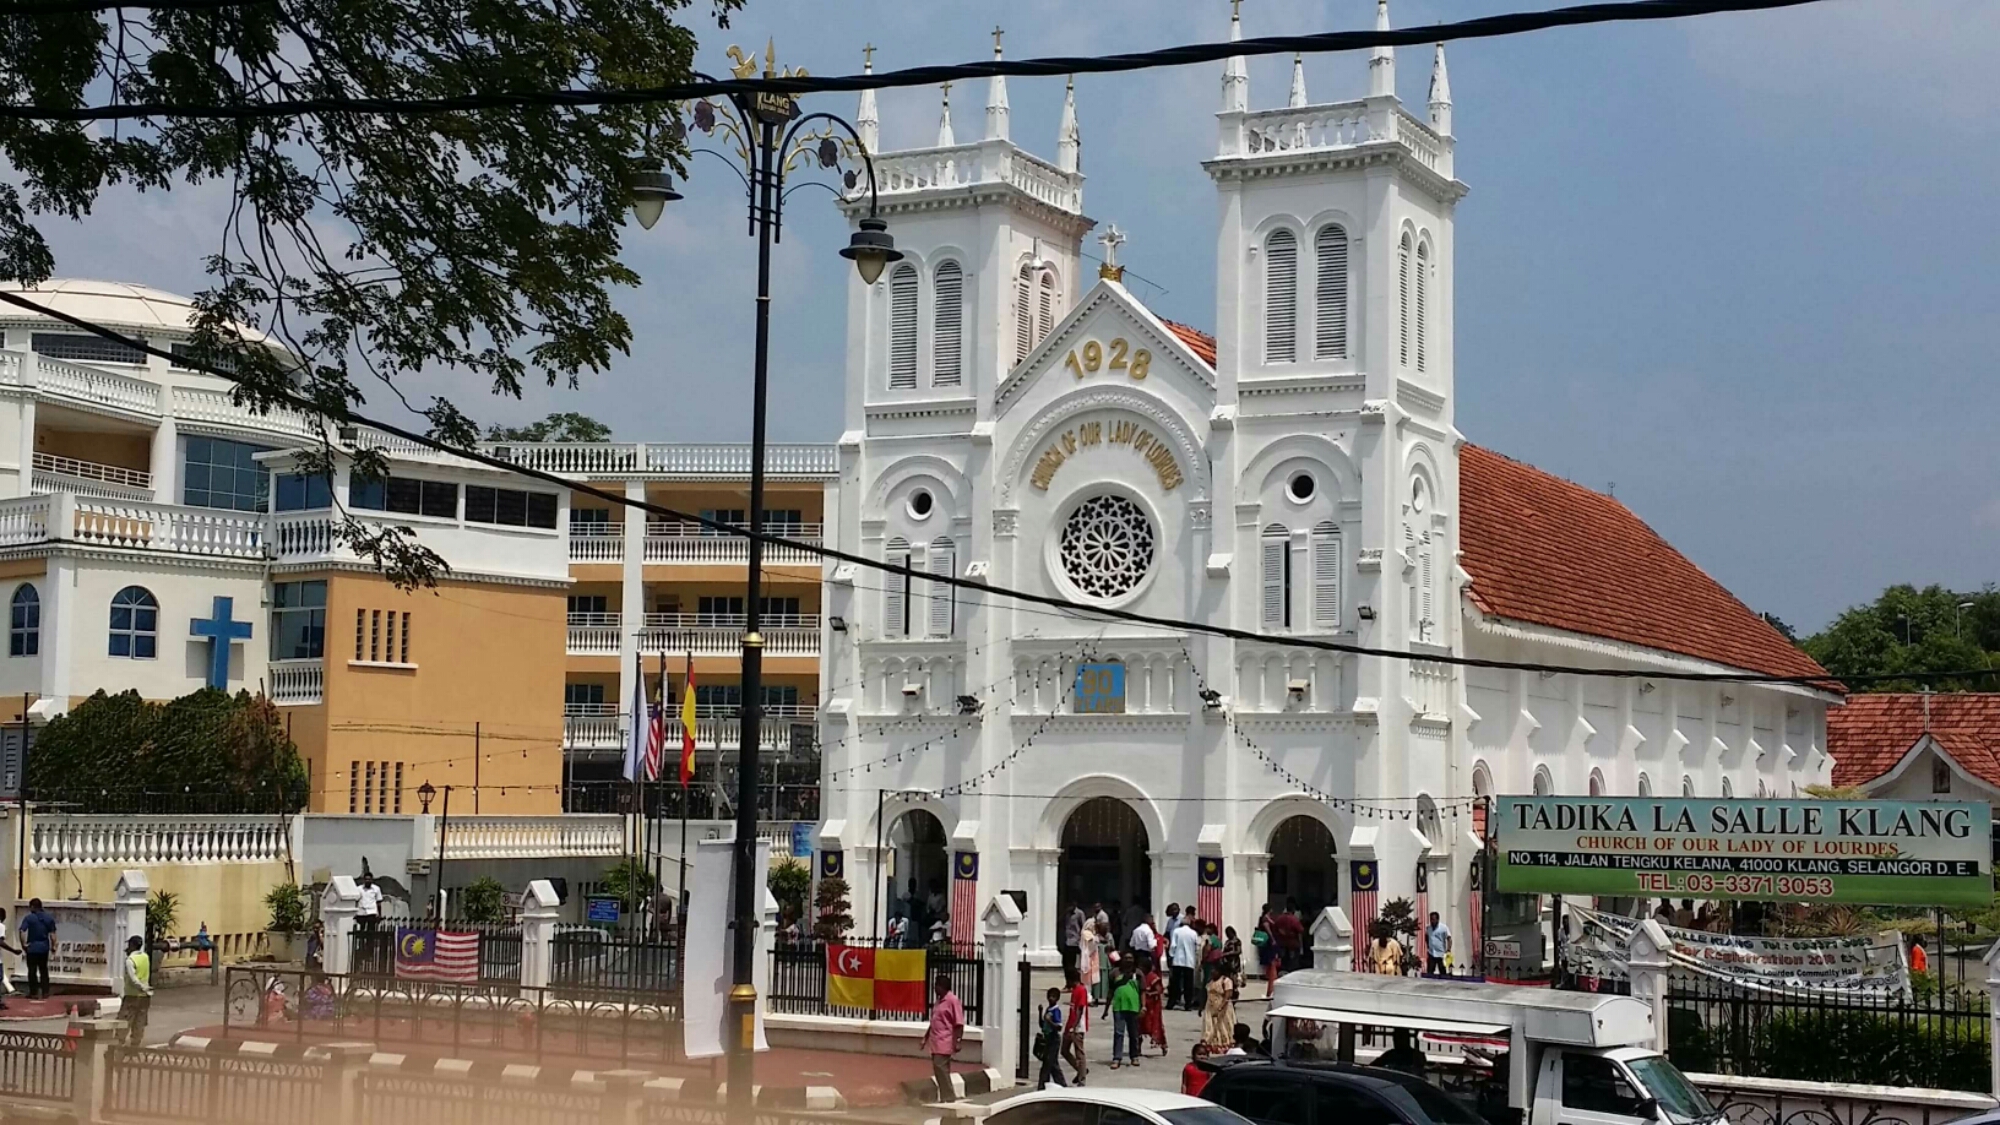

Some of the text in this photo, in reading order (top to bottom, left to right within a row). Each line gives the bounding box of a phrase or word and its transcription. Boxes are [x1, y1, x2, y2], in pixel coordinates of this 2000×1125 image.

[757, 92, 789, 110] KLANG
[1065, 338, 1152, 379] 1928
[1030, 420, 1184, 490] CHURCH OF OUR LADY OF LOURDES
[1082, 670, 1112, 695] 90
[1514, 804, 1970, 838] TADIKA LA SALLE KLANG
[1576, 836, 1899, 855] CHURCH OF OUR LADY OF LOURDES
[1511, 852, 1970, 876] NO. 114, JALAN TENGKU KELANA, 41000 KLANG, SELANGOR D. E.
[1676, 942, 1700, 958] For
[1711, 938, 1754, 950] KLANG
[1763, 968, 1794, 977] Lourdes
[1796, 969, 1839, 978] Community
[1842, 967, 1858, 976] Hall
